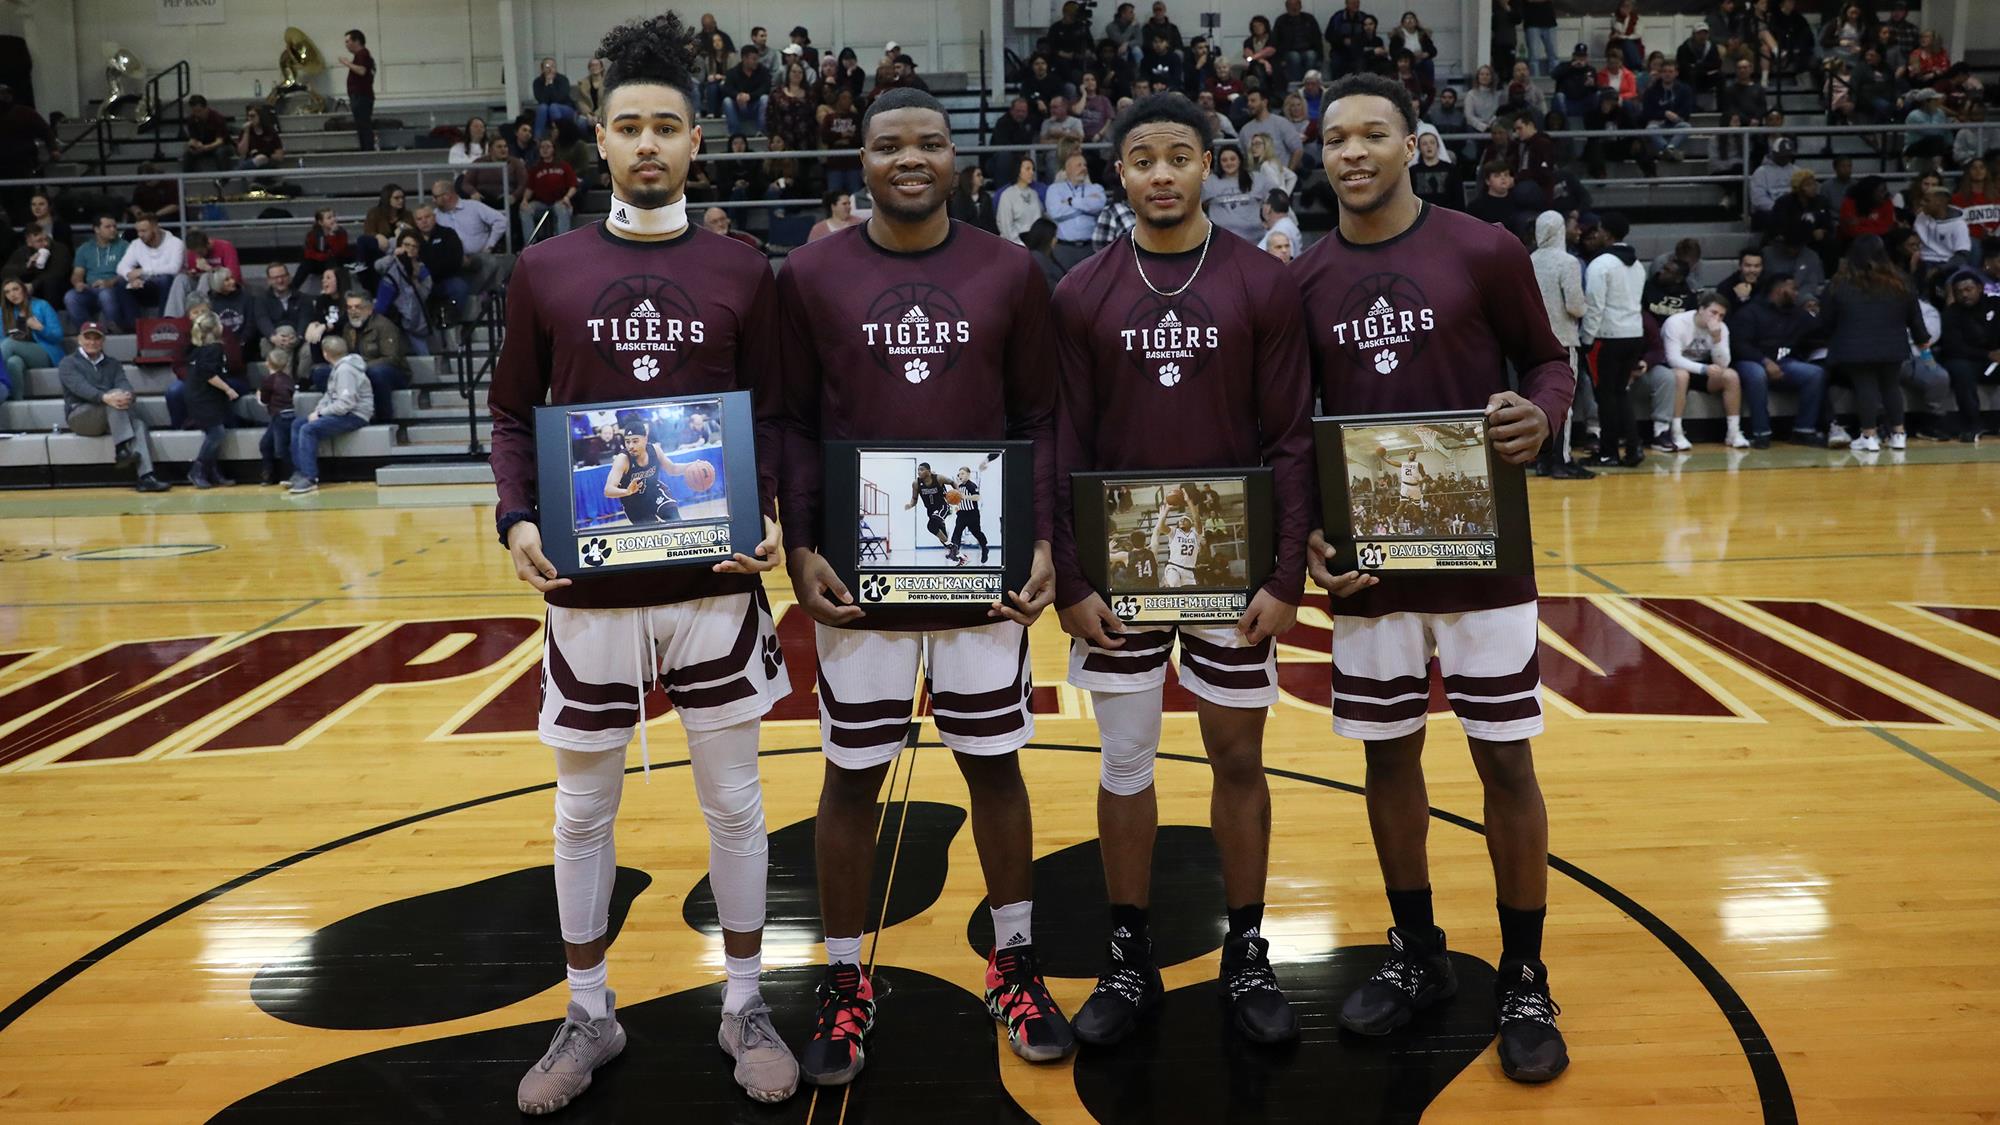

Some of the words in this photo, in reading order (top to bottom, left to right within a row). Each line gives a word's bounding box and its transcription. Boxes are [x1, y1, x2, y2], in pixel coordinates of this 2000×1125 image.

[630, 310, 661, 318] adidas
[1367, 306, 1394, 316] adidas
[587, 318, 705, 344] TIGERS
[862, 321, 970, 346] TIGERS
[1333, 308, 1435, 345] TIGERS
[615, 342, 677, 352] BASKETBALL
[1120, 327, 1219, 351] TIGERS
[1358, 334, 1411, 350] BASKETBALL
[888, 345, 945, 355] BASKETBALL
[1145, 350, 1195, 359] BASKETBALL
[588, 543, 601, 561] 4
[615, 533, 672, 551] RONALD
[674, 529, 727, 547] TAYLOR
[666, 548, 717, 558] BRADENTON,
[1180, 544, 1195, 556] 23
[1364, 548, 1383, 565] 21
[1389, 545, 1429, 557] DAVID
[1431, 544, 1494, 556] SIMMONS
[1135, 559, 1153, 578] 14
[870, 580, 879, 598] 1
[894, 576, 940, 591] KEVIN
[942, 576, 1000, 590] KANGNI
[1117, 602, 1137, 616] 23
[1144, 597, 1185, 609] RICHIE
[1187, 596, 1245, 608] MITCHELL
[1216, 611, 1235, 619] CITY,
